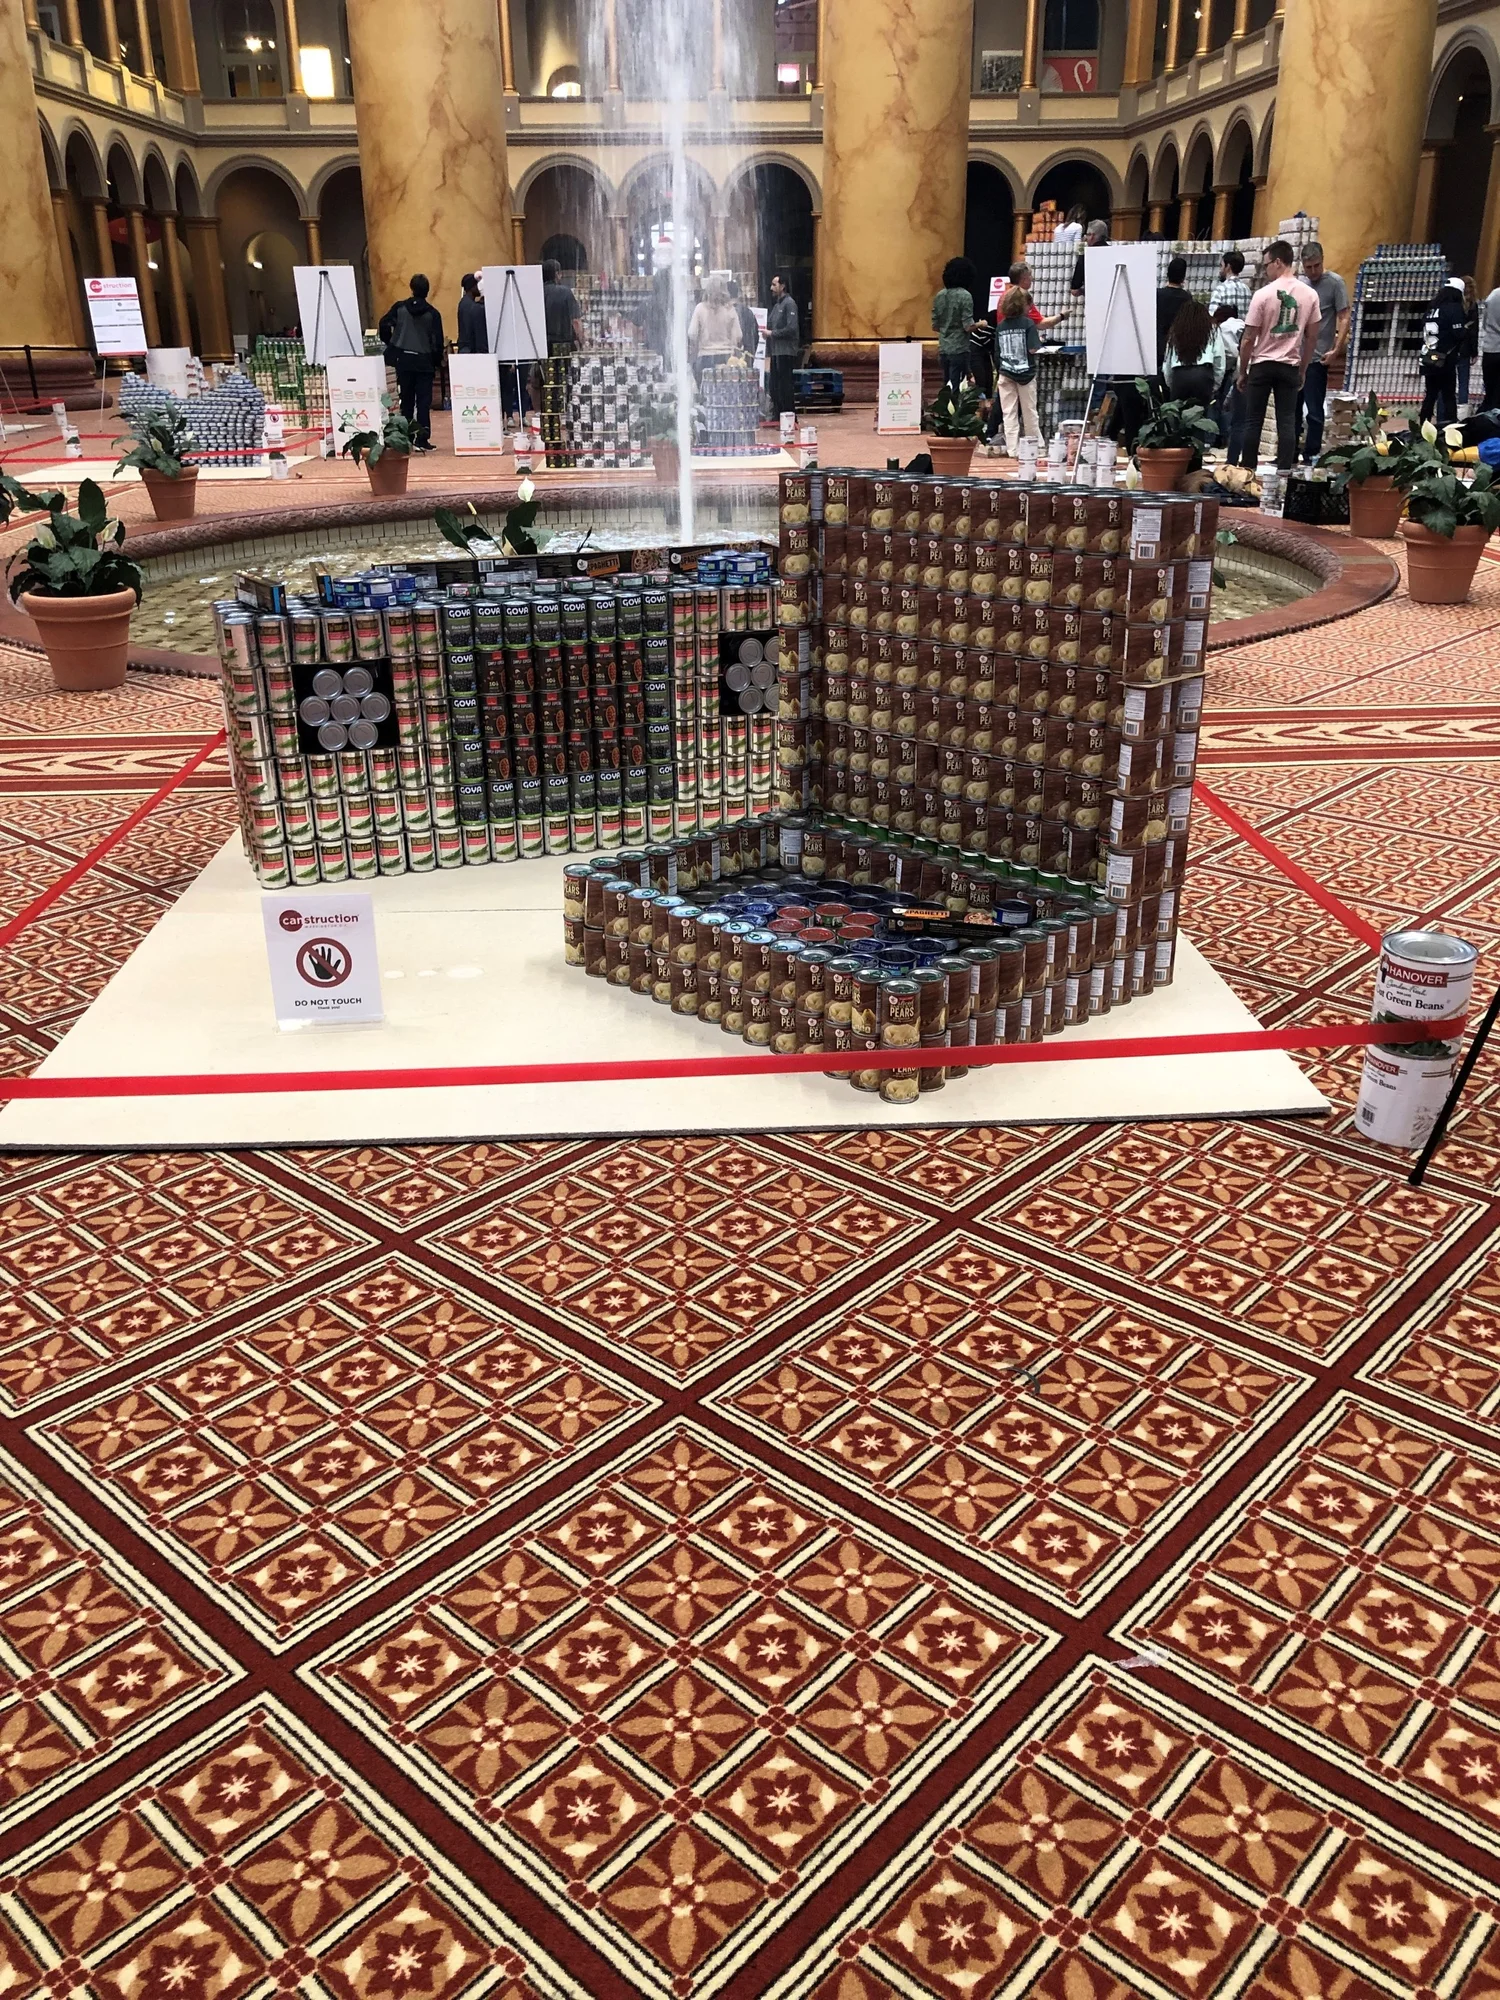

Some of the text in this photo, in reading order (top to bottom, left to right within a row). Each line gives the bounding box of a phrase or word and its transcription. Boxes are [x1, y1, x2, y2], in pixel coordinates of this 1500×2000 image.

[786, 488, 806, 498] PEARS
[1074, 509, 1087, 520] PEA
[790, 539, 808, 548] PEARS
[930, 551, 942, 560] PEA
[955, 554, 968, 563] PEA
[1010, 560, 1021, 569] PEA
[1031, 564, 1052, 573] PEARS
[1104, 571, 1115, 580] PEA
[856, 590, 867, 600] PEA
[478, 607, 500, 616] GOYA
[507, 607, 528, 616] GOYA
[537, 605, 558, 614] GOYA
[564, 603, 585, 612] GOYA
[955, 608, 968, 616] PEA
[449, 609, 470, 617] GOYA
[982, 611, 994, 620] PEA
[1036, 618, 1048, 628] PEA
[1065, 625, 1079, 634] PEA
[880, 647, 891, 656] PEA
[452, 655, 473, 664] GOYA
[980, 665, 992, 674] PEA
[454, 699, 476, 707] GOYA
[904, 702, 914, 710] PEA
[980, 715, 992, 724] PEA
[1034, 728, 1045, 736] PEA
[781, 734, 794, 743] EARS
[855, 738, 867, 747] PEA
[1090, 738, 1102, 748] PEA
[465, 742, 482, 751] GOY
[877, 744, 888, 753] PEA
[902, 750, 913, 760] PEA
[493, 783, 513, 792] GOYA
[878, 789, 889, 798] PEA
[1082, 793, 1100, 801] PEAR
[926, 802, 937, 811] PEA
[945, 809, 960, 818] PEAR
[1027, 829, 1038, 838] PEA
[805, 844, 822, 852] PEARS
[859, 857, 870, 866] PEA
[951, 883, 966, 893] PEAR
[970, 892, 989, 903] PEARS
[282, 914, 358, 925] canstruction
[683, 928, 695, 937] PEA
[659, 967, 670, 976] PEA
[1390, 966, 1443, 985] HANOVER
[684, 978, 697, 987] PEA
[1386, 992, 1412, 1007] Green
[1415, 1000, 1444, 1010] Beans
[752, 1008, 770, 1016] PEAR
[890, 1007, 914, 1017] PEARS
[810, 1029, 823, 1037] PEA
[836, 1040, 850, 1049] PEA
